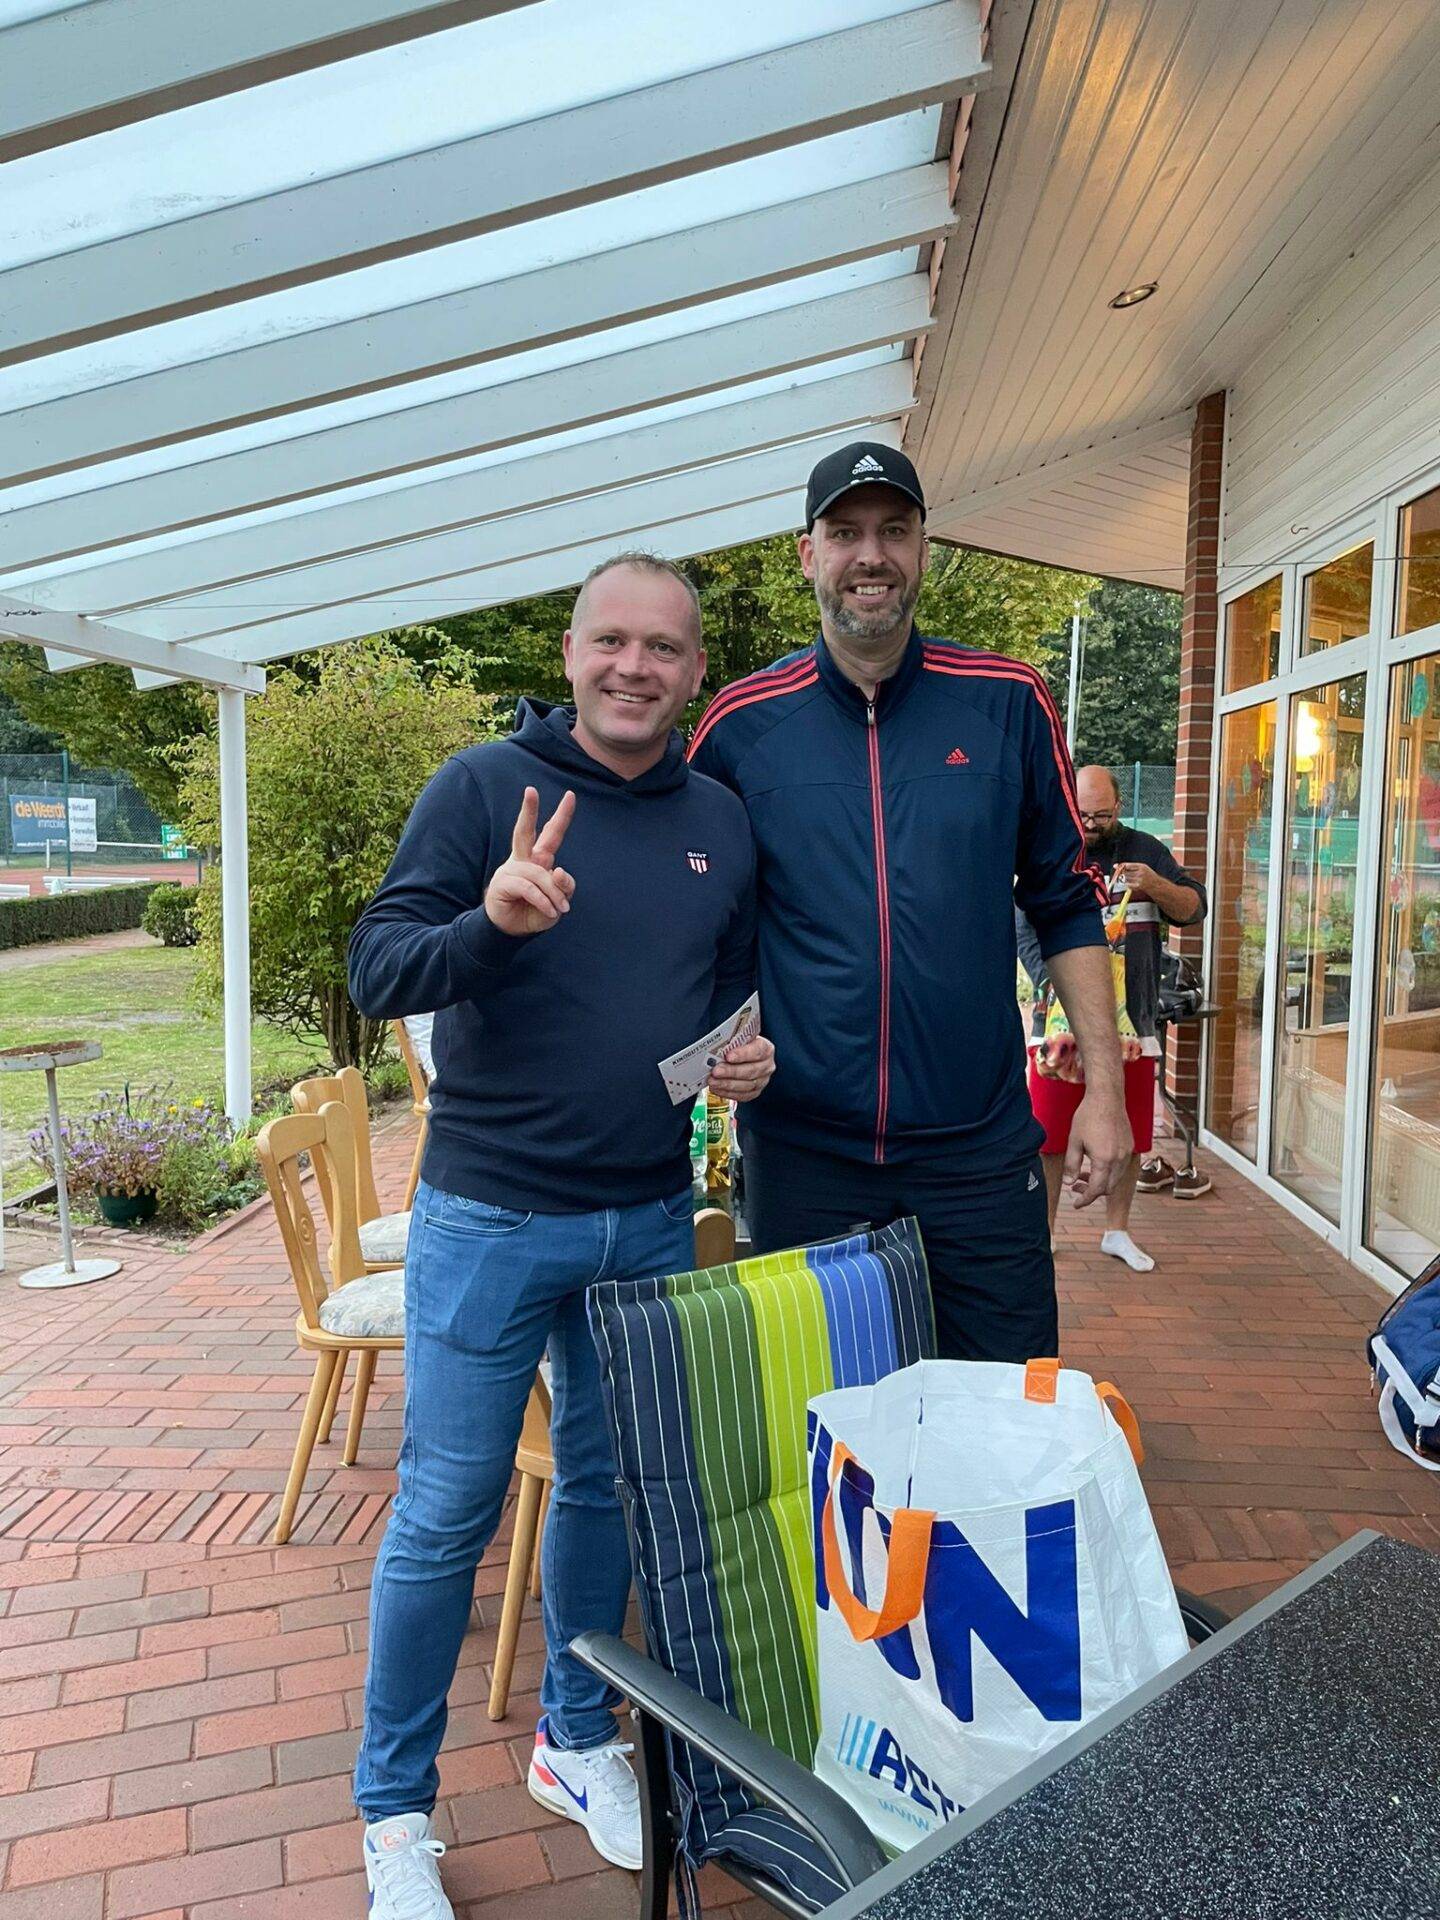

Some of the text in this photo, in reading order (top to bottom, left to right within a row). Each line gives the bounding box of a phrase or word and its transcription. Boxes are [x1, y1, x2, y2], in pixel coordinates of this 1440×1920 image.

[852, 465, 884, 475] adidas
[686, 851, 707, 859] GANT
[869, 1728, 966, 1823] ACT
